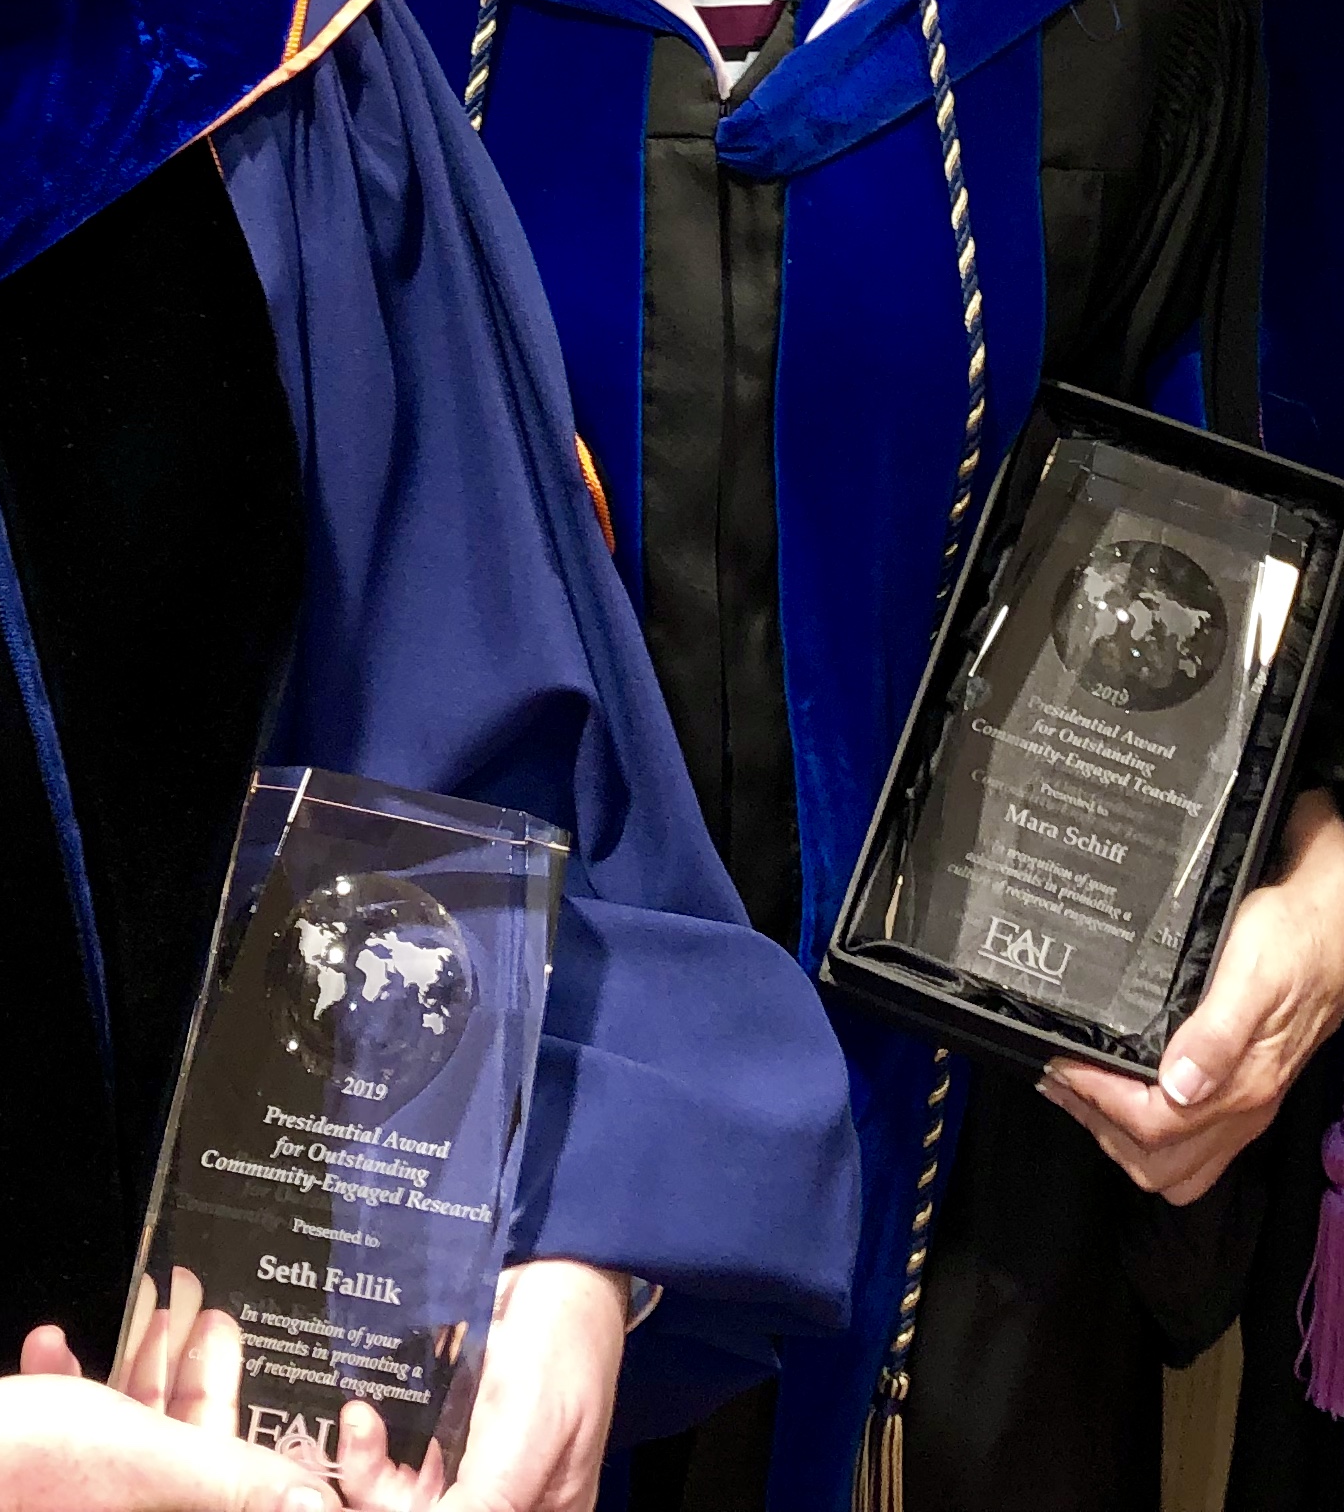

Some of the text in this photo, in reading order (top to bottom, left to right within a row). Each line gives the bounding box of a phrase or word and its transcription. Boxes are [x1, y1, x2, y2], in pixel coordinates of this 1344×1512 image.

[1091, 682, 1129, 707] 2019
[1029, 718, 1156, 778] for Outstanding
[1120, 730, 1177, 760] Award
[1134, 776, 1203, 818] Teaching
[1005, 803, 1059, 839] Mara
[1062, 826, 1129, 865] Schiff
[980, 915, 1078, 980] FAU
[341, 1076, 388, 1101] 2019
[263, 1105, 451, 1159] Presidential Award
[200, 1149, 493, 1224] Community-Engaged Research
[270, 1135, 430, 1188] for Outstanding
[291, 1218, 381, 1248] Presented to
[256, 1254, 402, 1306] Seth Fallik
[240, 1303, 402, 1349] In recognition of your
[239, 1328, 309, 1357] evements
[312, 1342, 329, 1360] in
[330, 1349, 411, 1381] promoting
[411, 1365, 423, 1379] a
[246, 1356, 266, 1377] of
[264, 1361, 340, 1384] reciprocal
[340, 1375, 432, 1405] engagement
